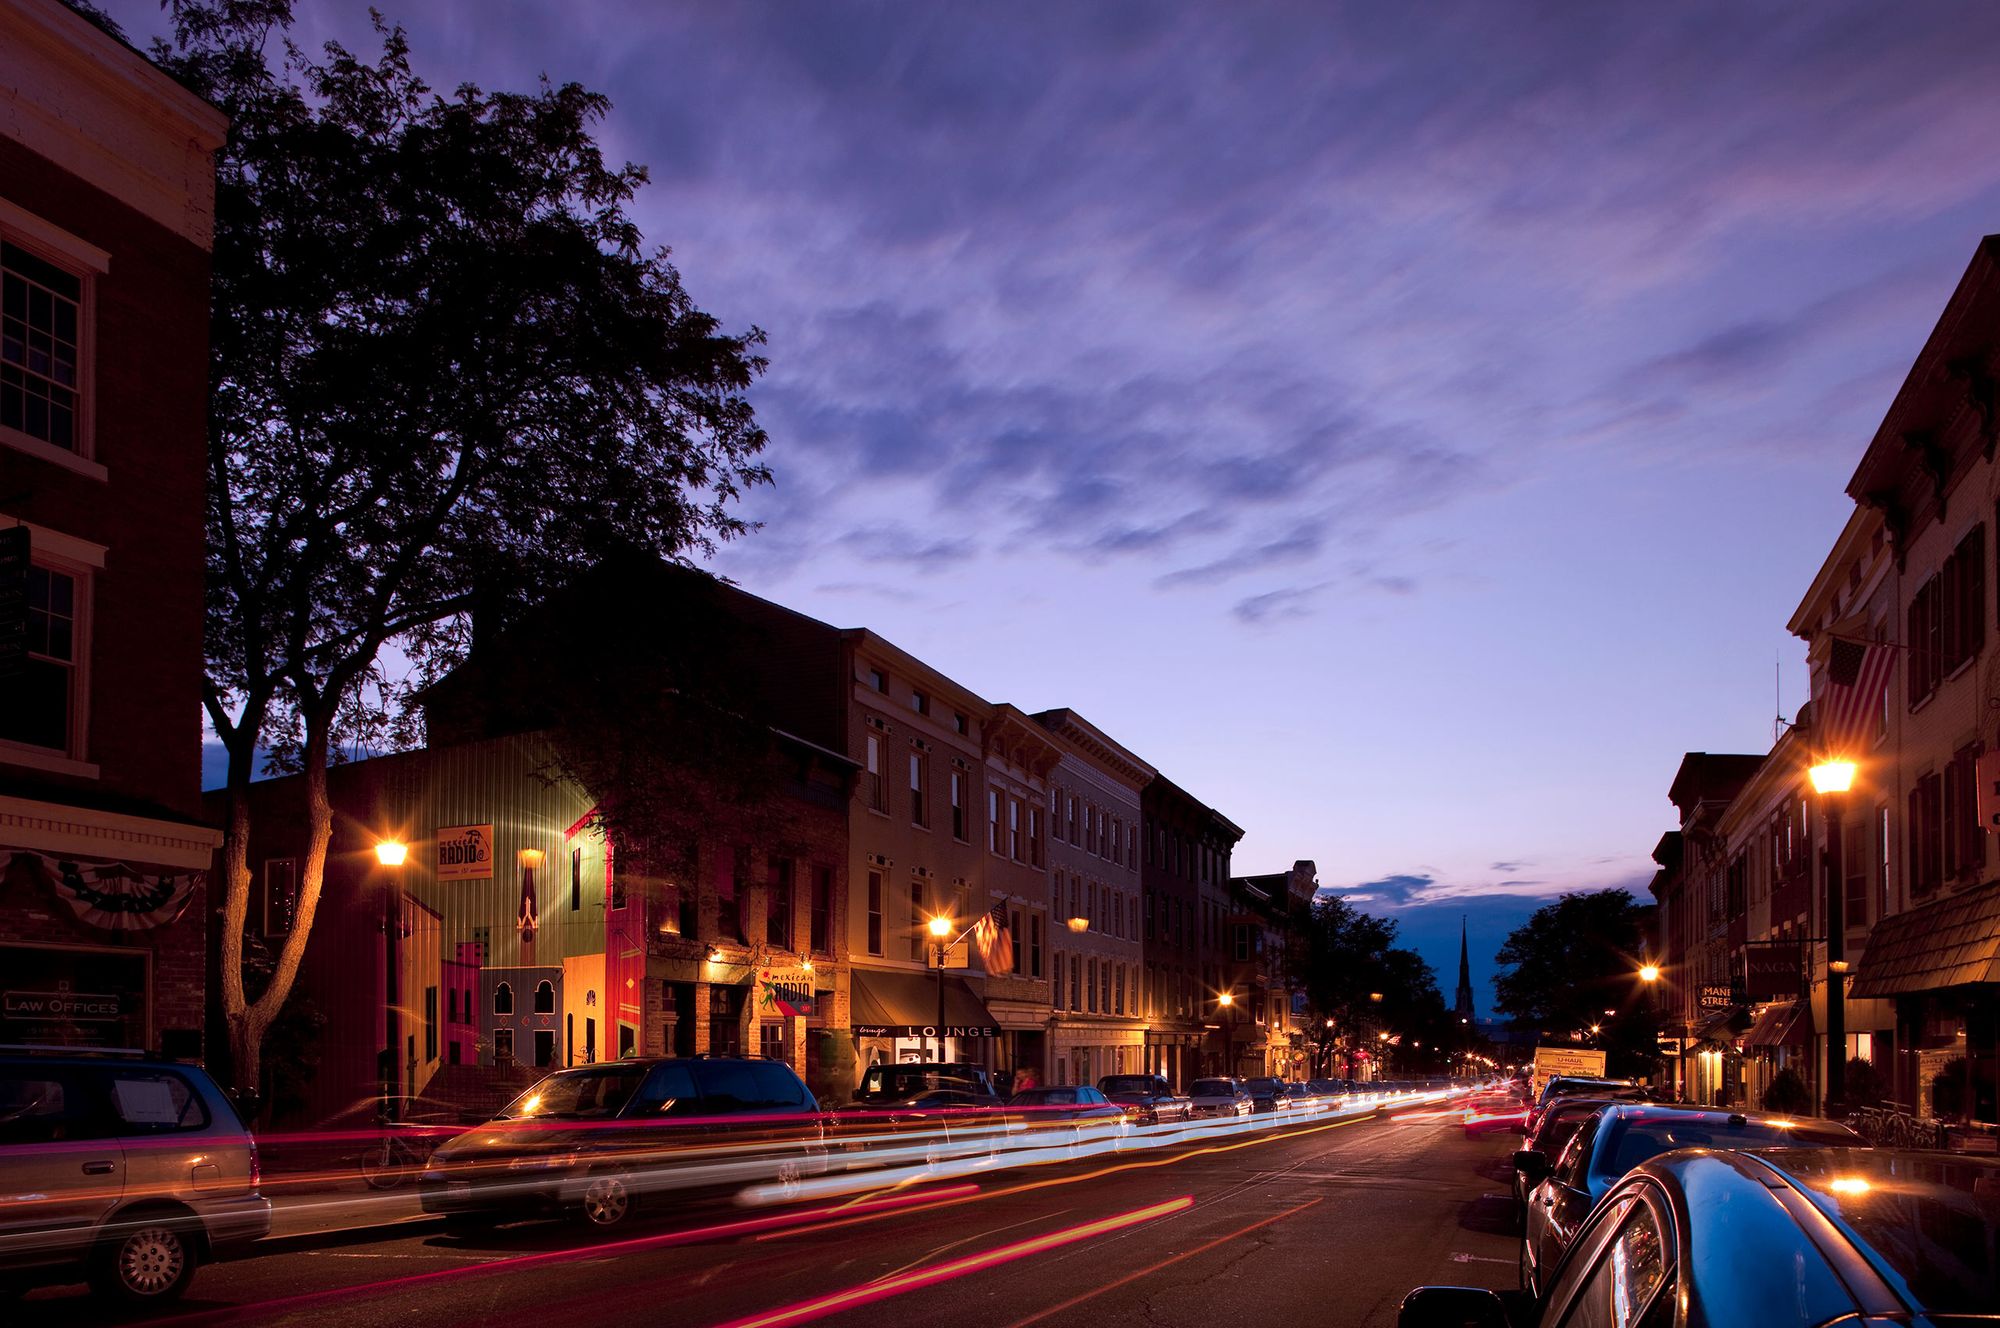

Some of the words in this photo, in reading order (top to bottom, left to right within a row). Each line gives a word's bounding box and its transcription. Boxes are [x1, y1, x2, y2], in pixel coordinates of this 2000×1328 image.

[440, 845, 476, 865] RADIO
[1750, 962, 1797, 973] NAGA
[772, 973, 814, 981] mexican
[776, 983, 809, 1002] RADIO
[1704, 987, 1732, 996] MANE
[6, 998, 44, 1011] LAW
[49, 1000, 119, 1014] OFFICES
[1702, 997, 1731, 1006] STREE
